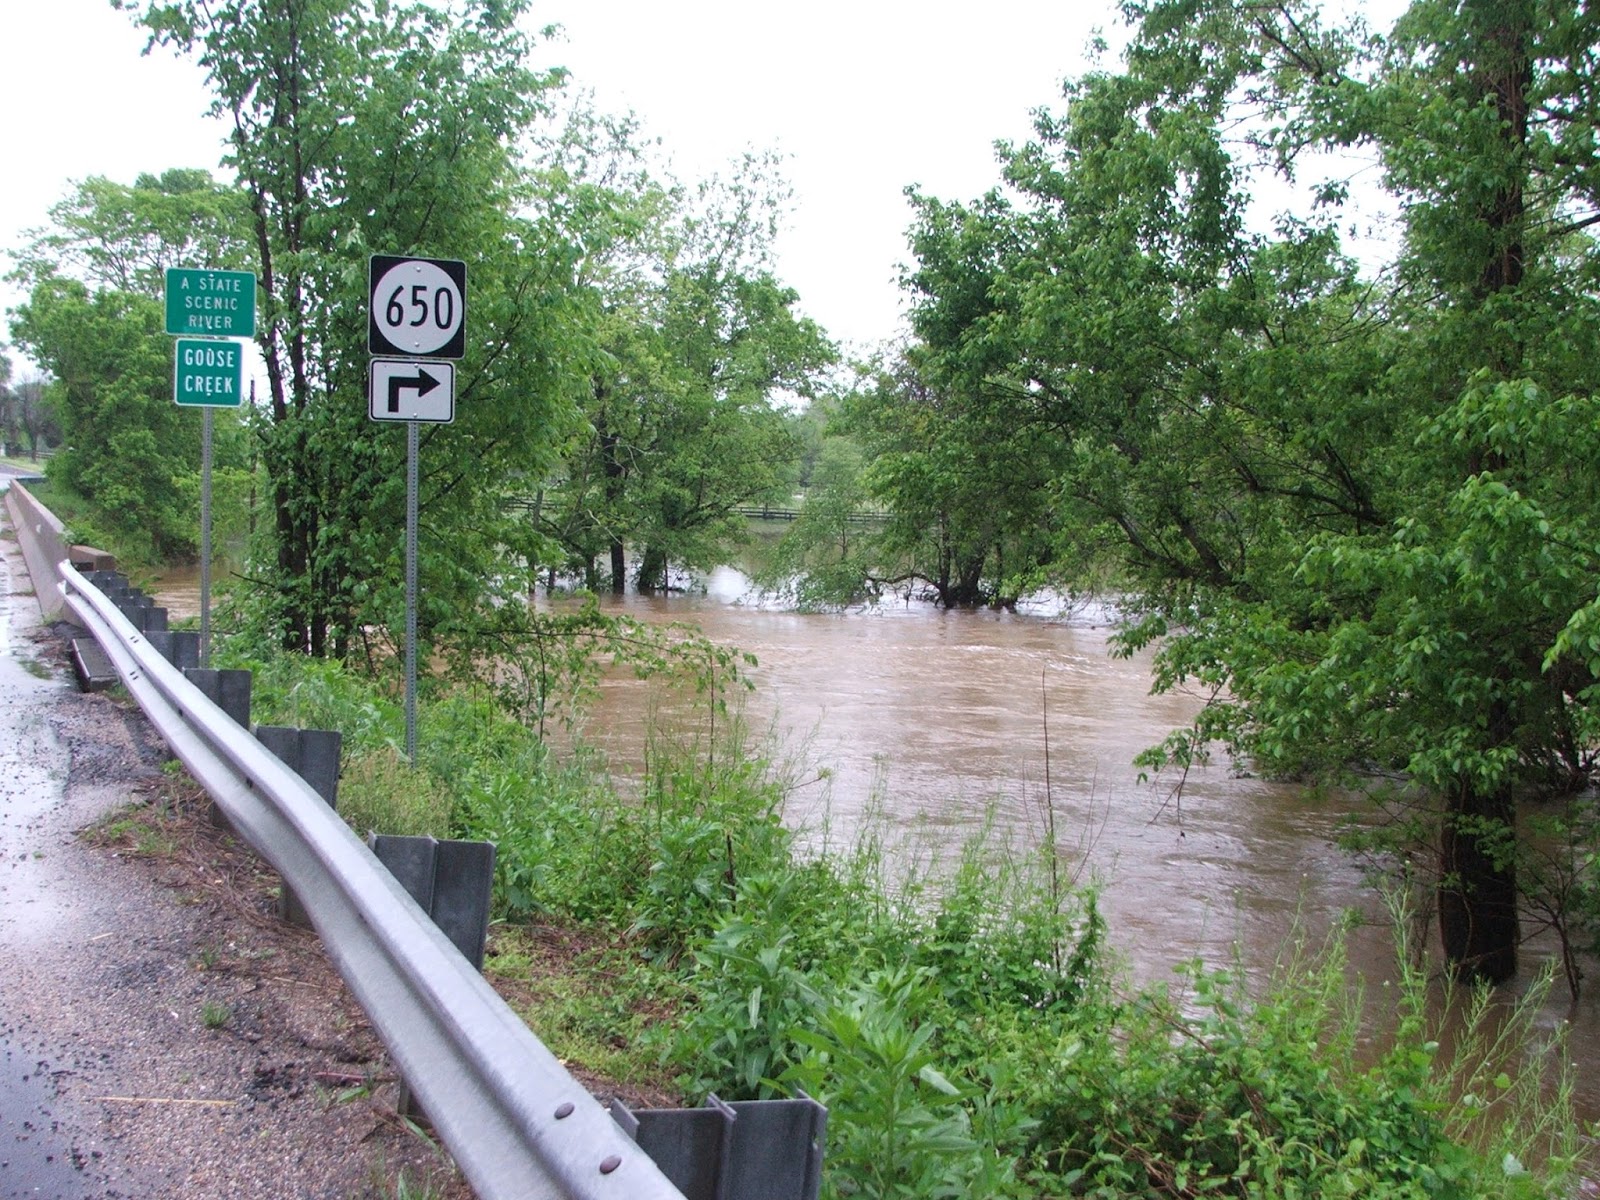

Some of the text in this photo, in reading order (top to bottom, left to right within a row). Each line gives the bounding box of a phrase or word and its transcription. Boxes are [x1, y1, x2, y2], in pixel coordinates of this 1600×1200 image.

[181, 277, 242, 292] A STATE
[185, 296, 239, 311] SCENIC
[386, 285, 453, 330] 650
[188, 315, 233, 329] RIVER
[184, 348, 235, 368] GOOSE
[184, 375, 233, 394] CREEK
